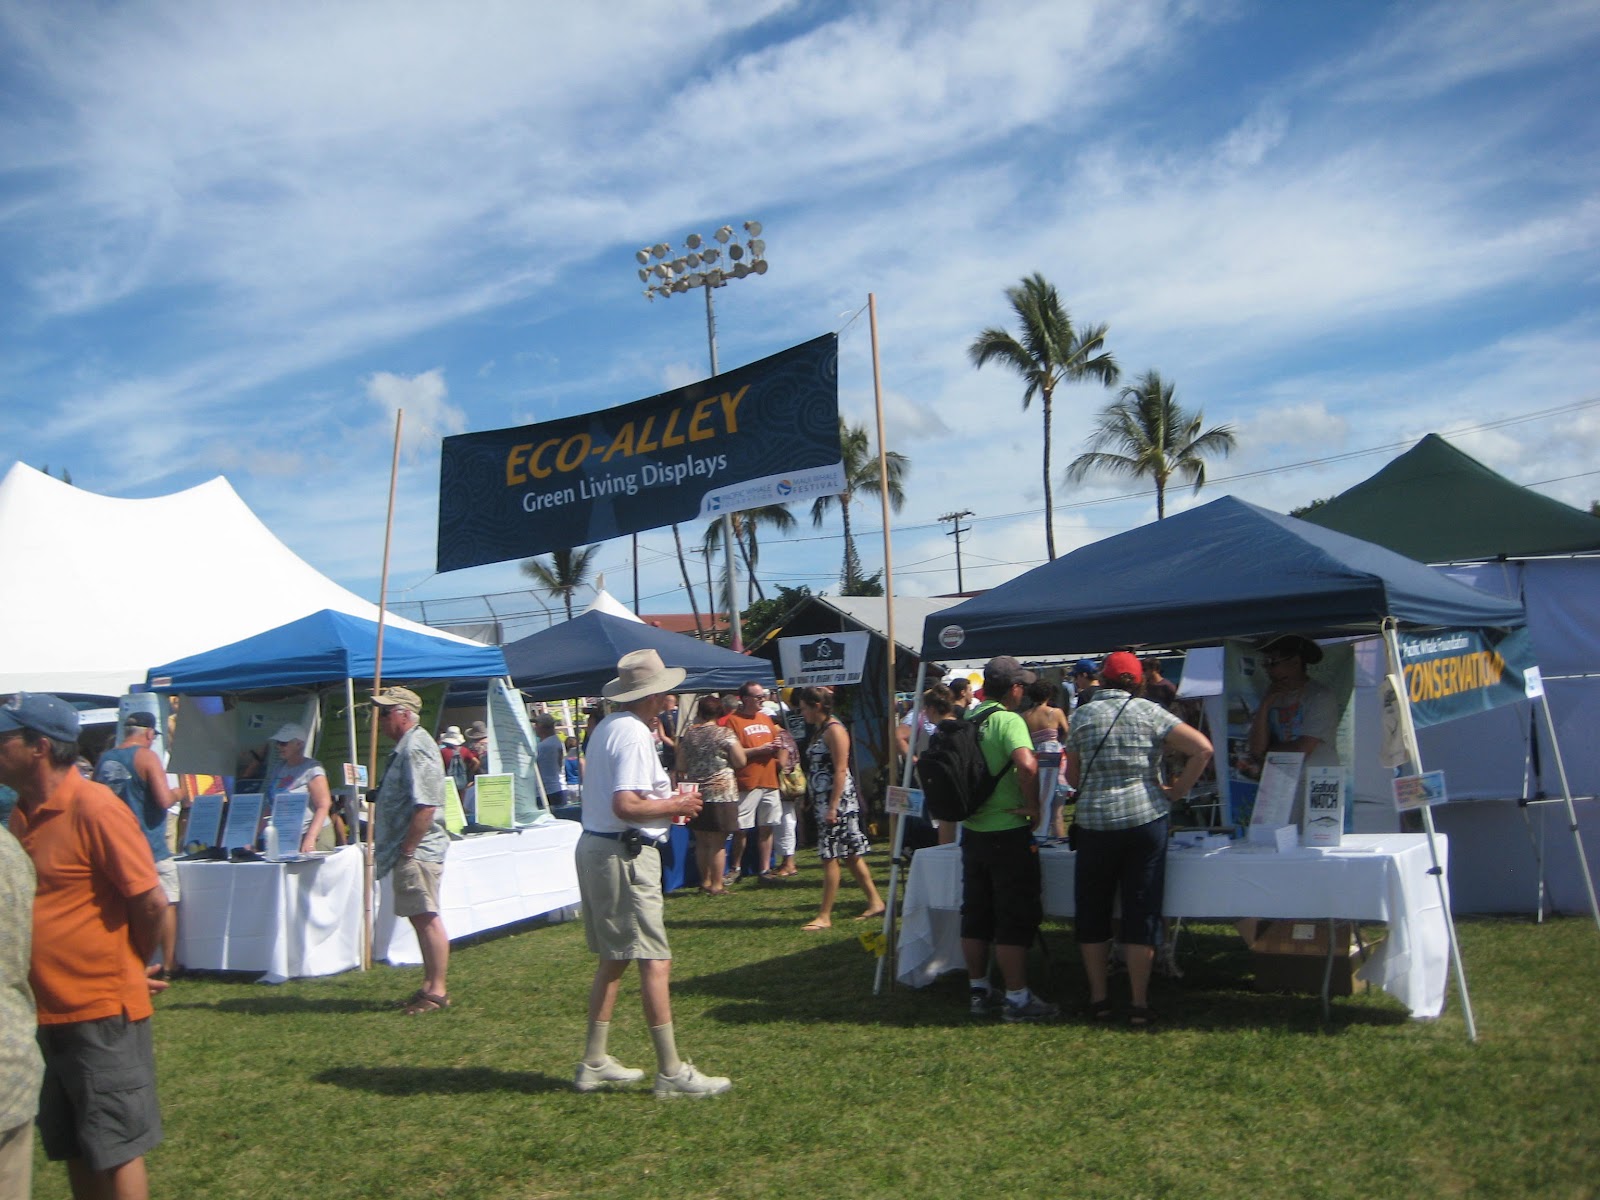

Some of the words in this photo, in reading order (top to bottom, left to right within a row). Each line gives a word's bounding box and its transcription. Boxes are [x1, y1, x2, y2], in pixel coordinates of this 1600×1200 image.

[505, 383, 752, 486] ECO-ALLEY
[523, 486, 575, 513] Green
[580, 471, 638, 496] Living
[642, 453, 727, 485] Displays
[793, 481, 839, 494] FESTIVAL
[743, 724, 772, 736] TEXAS
[1311, 780, 1339, 794] Seafood
[1310, 793, 1338, 809] WATCH
